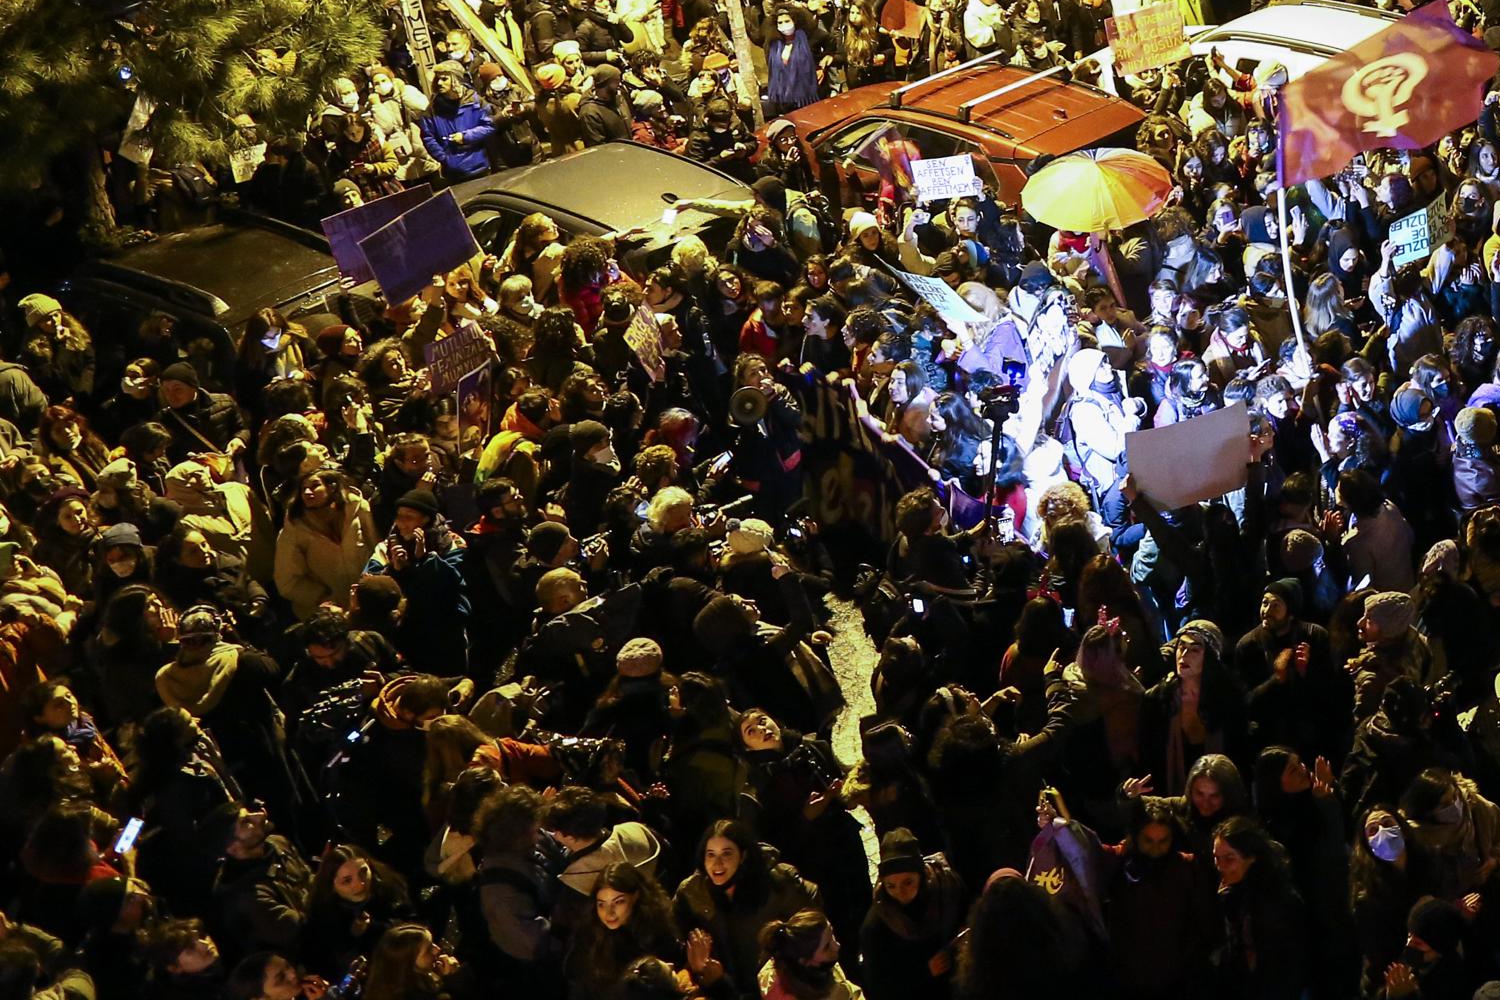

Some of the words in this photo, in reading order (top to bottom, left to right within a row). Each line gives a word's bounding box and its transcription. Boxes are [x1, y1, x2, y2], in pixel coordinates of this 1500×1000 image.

[926, 159, 946, 169] SEN
[917, 165, 964, 178] AFFETSEN
[931, 176, 951, 186] BEN
